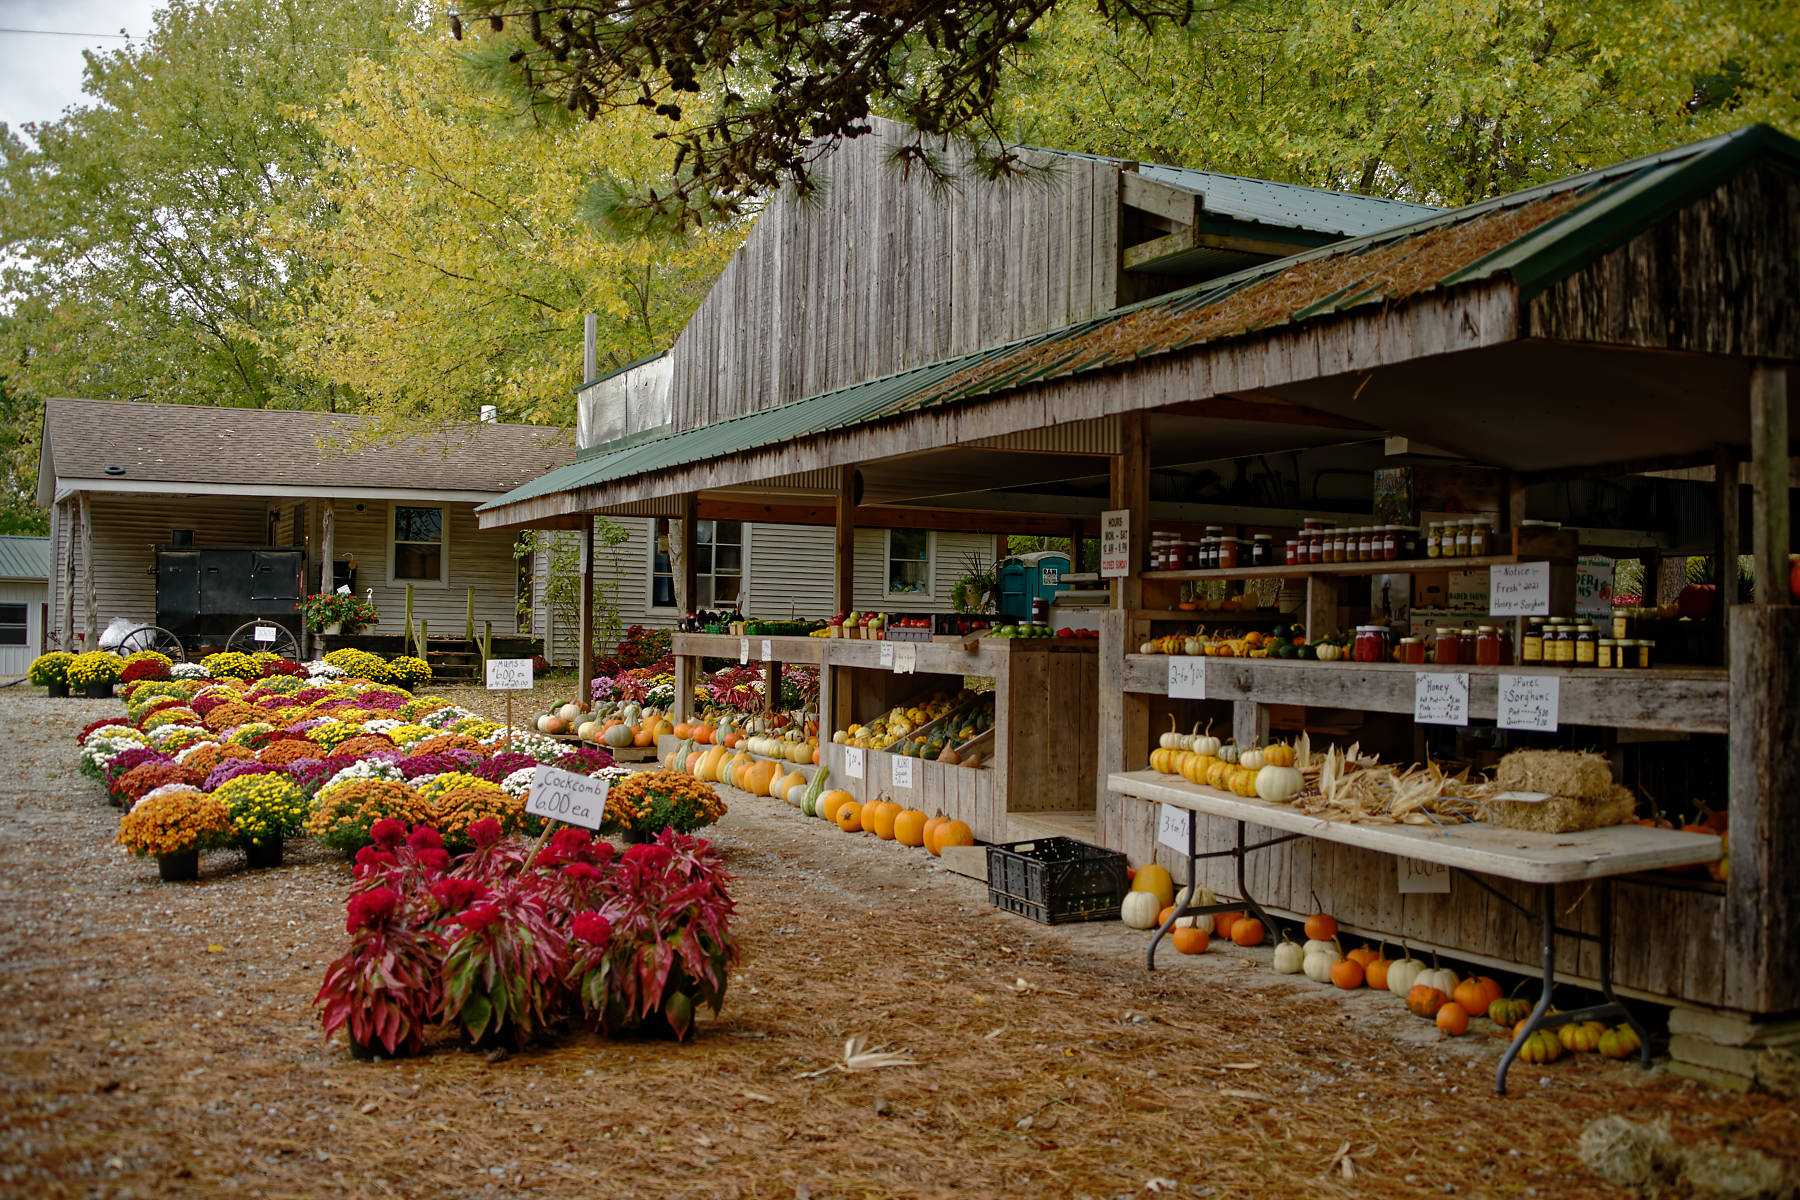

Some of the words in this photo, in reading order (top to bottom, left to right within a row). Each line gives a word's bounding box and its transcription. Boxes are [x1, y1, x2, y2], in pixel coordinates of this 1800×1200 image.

[1108, 517, 1123, 528] HOURS
[1504, 567, 1531, 577] Notice
[1496, 582, 1518, 593] Fresh
[1520, 599, 1545, 612] Sorghum
[498, 660, 519, 669] MUMS
[1427, 680, 1450, 696] Honey
[1506, 689, 1545, 707] Sorghum
[544, 770, 602, 796] Cockcomb
